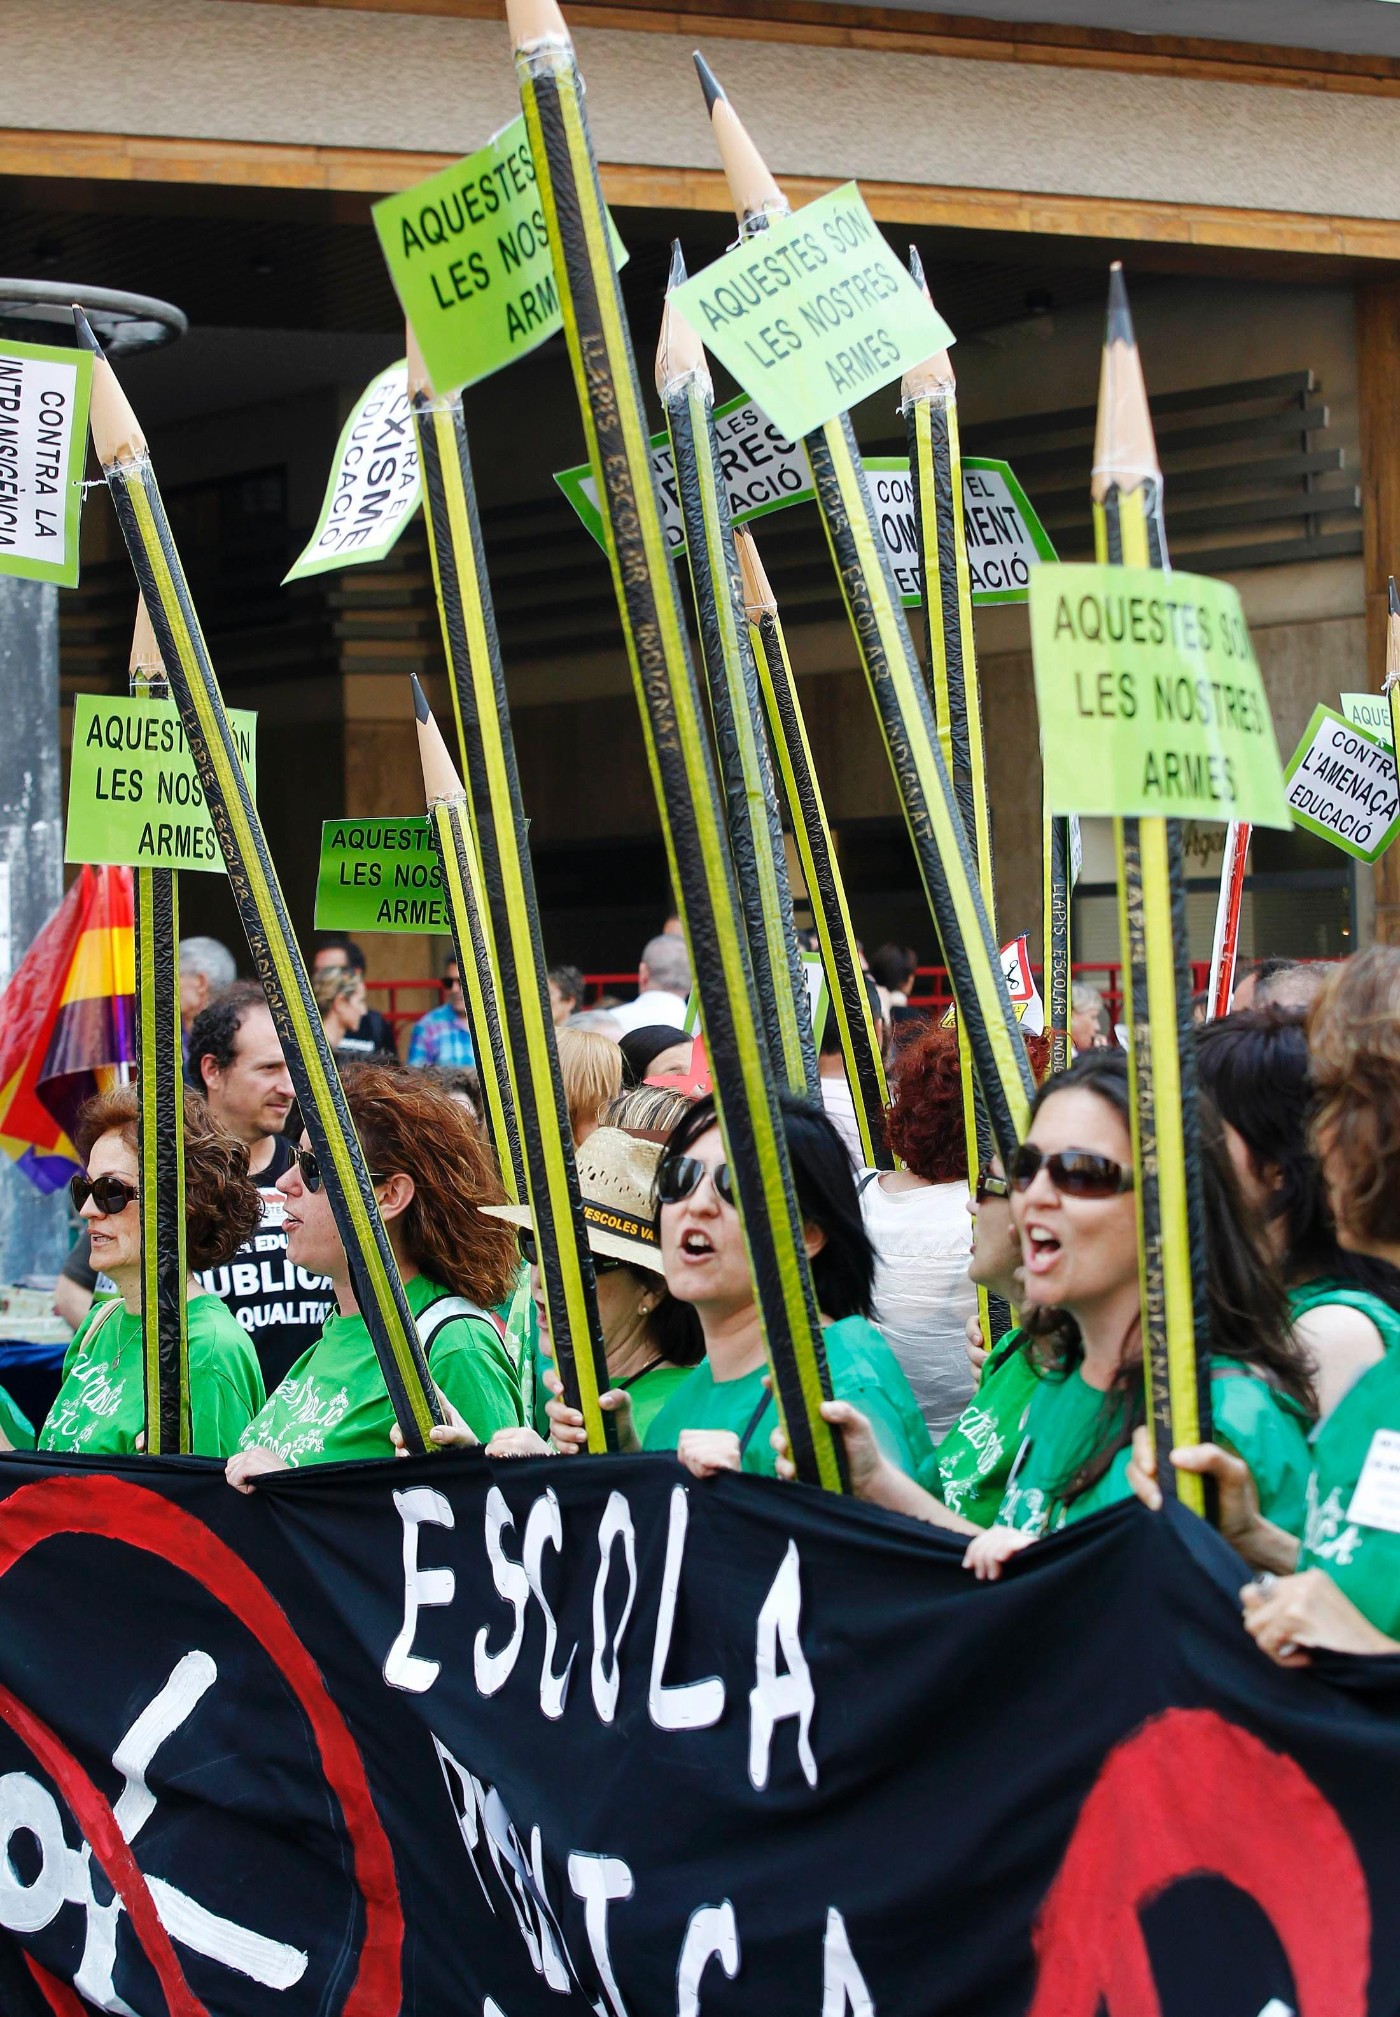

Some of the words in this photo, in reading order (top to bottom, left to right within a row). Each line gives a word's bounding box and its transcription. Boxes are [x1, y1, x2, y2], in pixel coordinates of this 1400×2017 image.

[401, 144, 537, 258] AQUESTES
[430, 252, 490, 310] LES
[698, 233, 828, 332] AQUESTES
[822, 206, 872, 254] SÓN
[744, 318, 802, 369] LES
[797, 262, 899, 338] NOSTRES
[824, 328, 901, 395] ARMES
[35, 390, 66, 495] CONTRA
[715, 409, 759, 442] LES
[319, 383, 397, 547] EDUCACIÓ
[965, 476, 995, 498] EL
[35, 508, 58, 538] LA
[379, 498, 408, 528] EL
[1054, 595, 1213, 651] AQUESTES
[1075, 670, 1138, 720] LES
[1154, 676, 1265, 736] NOSTRES
[86, 713, 191, 754] AQUEST
[96, 767, 142, 803] LES
[1142, 749, 1238, 802] ARMES
[1301, 746, 1399, 821] L'AMENAÇA
[138, 822, 216, 860] ARMES
[331, 828, 437, 852] AQUESTE
[1288, 783, 1373, 844] EDUCACIÓ
[340, 861, 382, 886] LES
[1052, 883, 1067, 936] LLAPIS
[1052, 949, 1067, 1016] ESCOLAR
[235, 1301, 332, 1333] QUALITAT
[382, 1484, 818, 1792] ESCOLA
